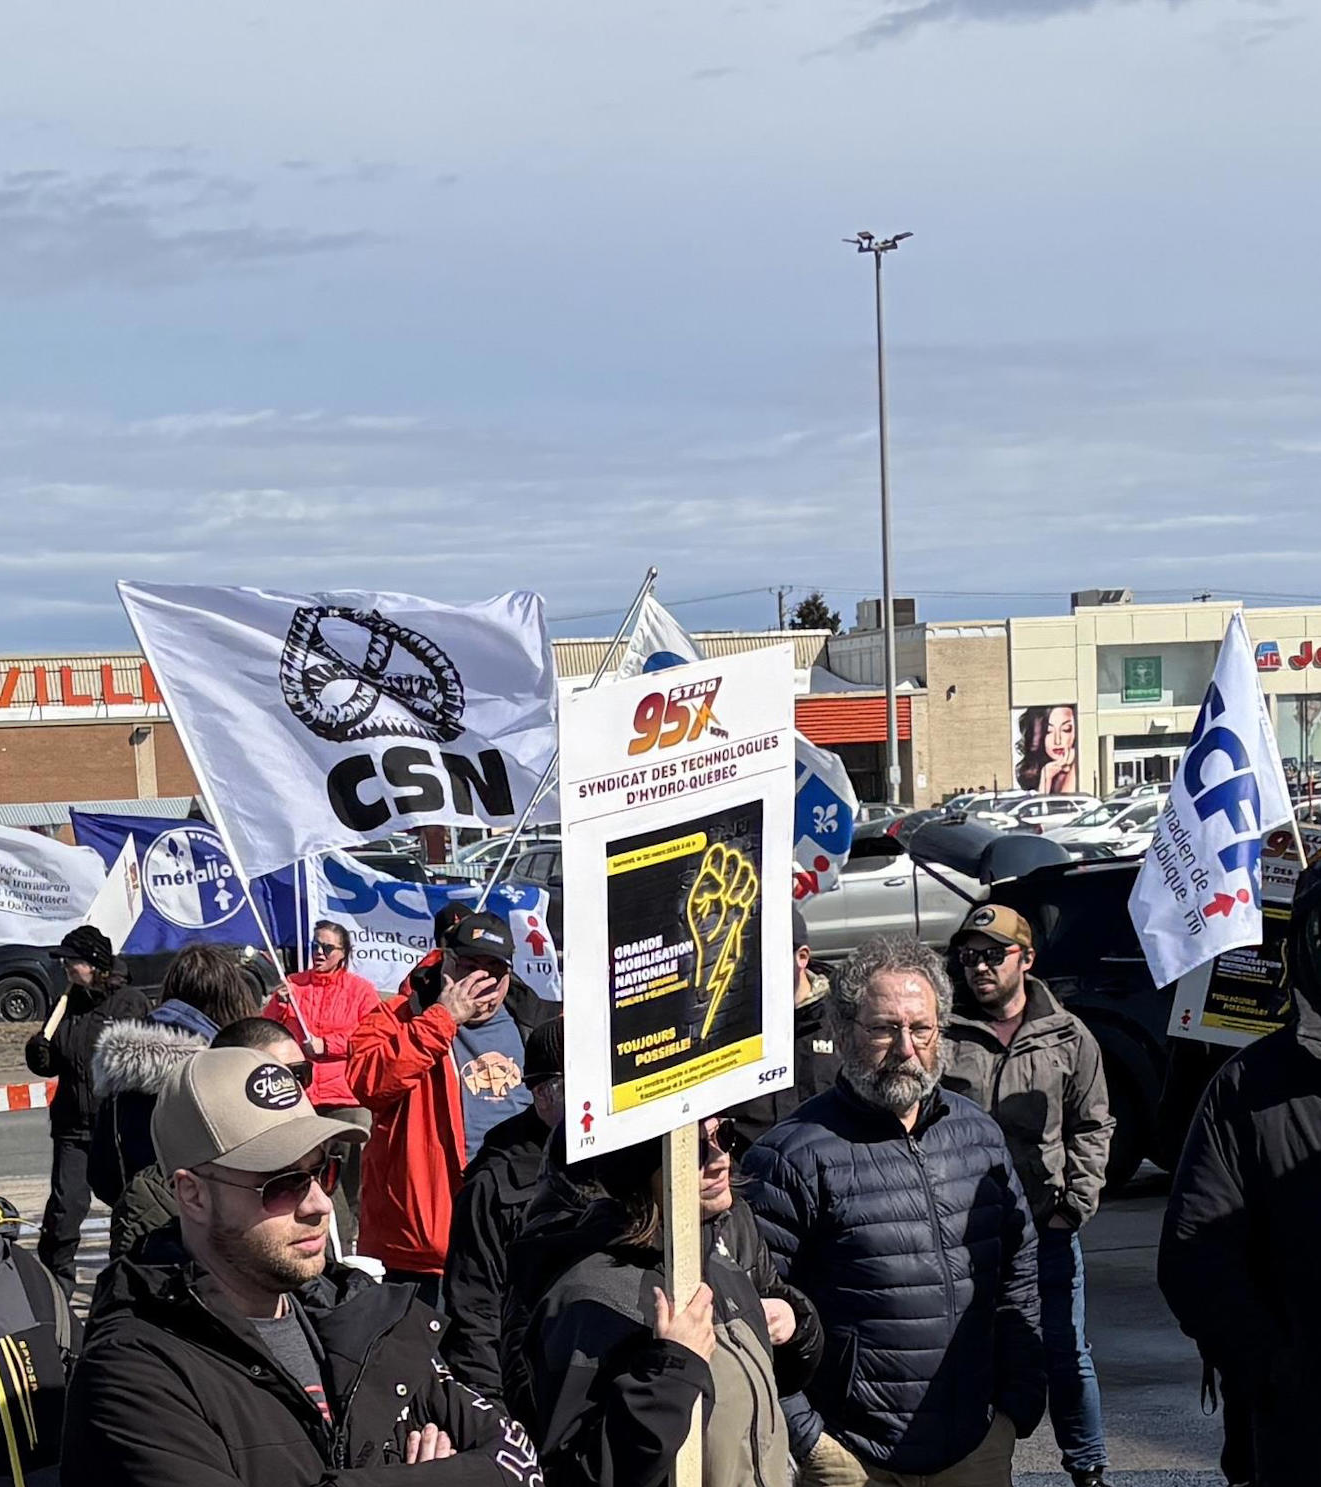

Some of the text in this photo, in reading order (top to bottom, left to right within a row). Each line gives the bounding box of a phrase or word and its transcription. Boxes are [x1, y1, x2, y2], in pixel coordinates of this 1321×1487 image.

[579, 735, 779, 799] SYNDICAT DES TECHNOLOGUES
[327, 745, 515, 832] CSN
[152, 860, 234, 887] métallo
[1189, 864, 1209, 893] de
[350, 926, 402, 945] ndicat
[614, 935, 663, 960] GRANDE
[614, 940, 695, 975] MOBILISATION
[615, 959, 678, 990] NATIONALE
[617, 1026, 676, 1056] TOUJOURS
[758, 1066, 788, 1085] SCFP
